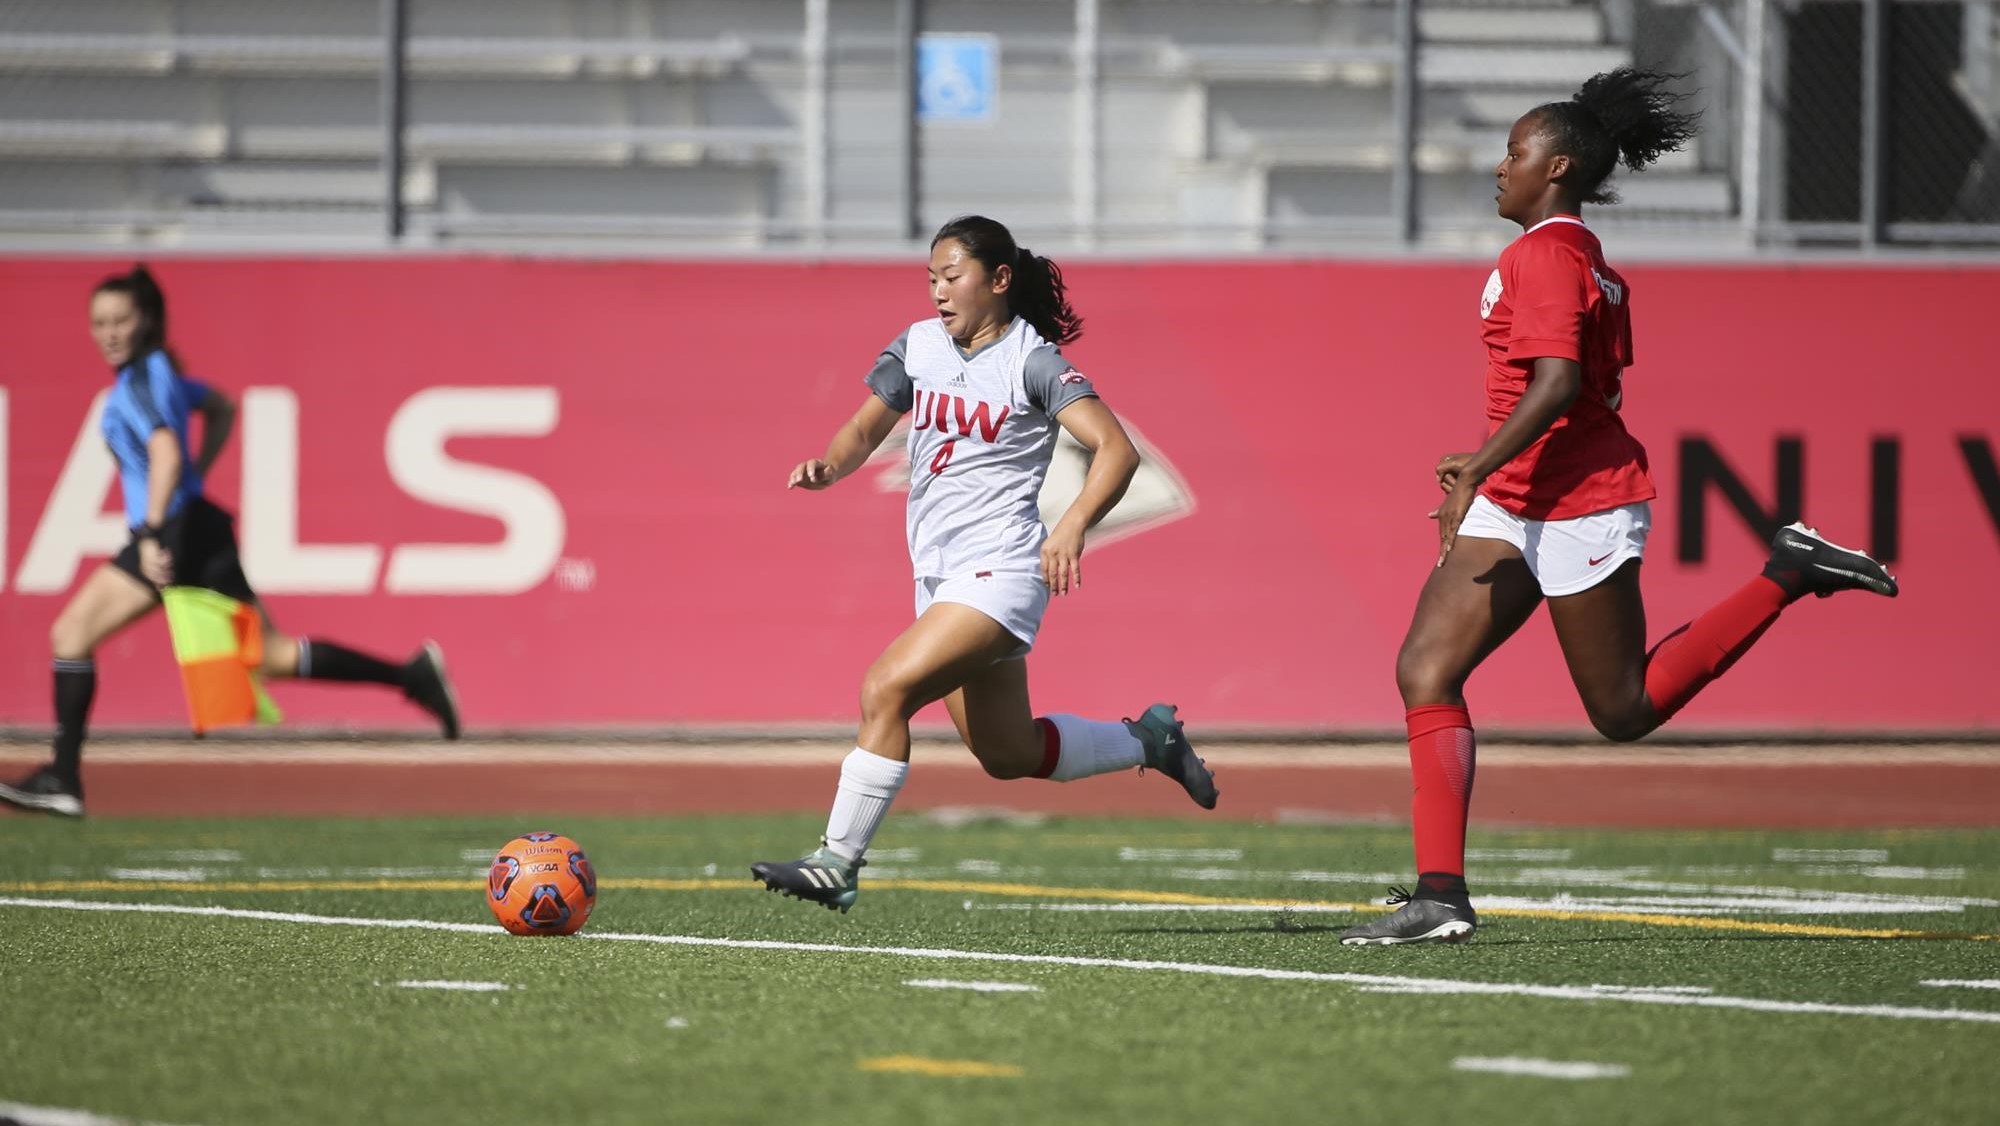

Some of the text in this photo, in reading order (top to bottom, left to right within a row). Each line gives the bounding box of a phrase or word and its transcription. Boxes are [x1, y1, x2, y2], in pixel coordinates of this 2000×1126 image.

[914, 389, 1010, 444] UIW
[929, 438, 957, 476] 4
[0, 386, 566, 596] ALS
[525, 845, 563, 855] Wilson
[529, 863, 559, 873] NCAA
